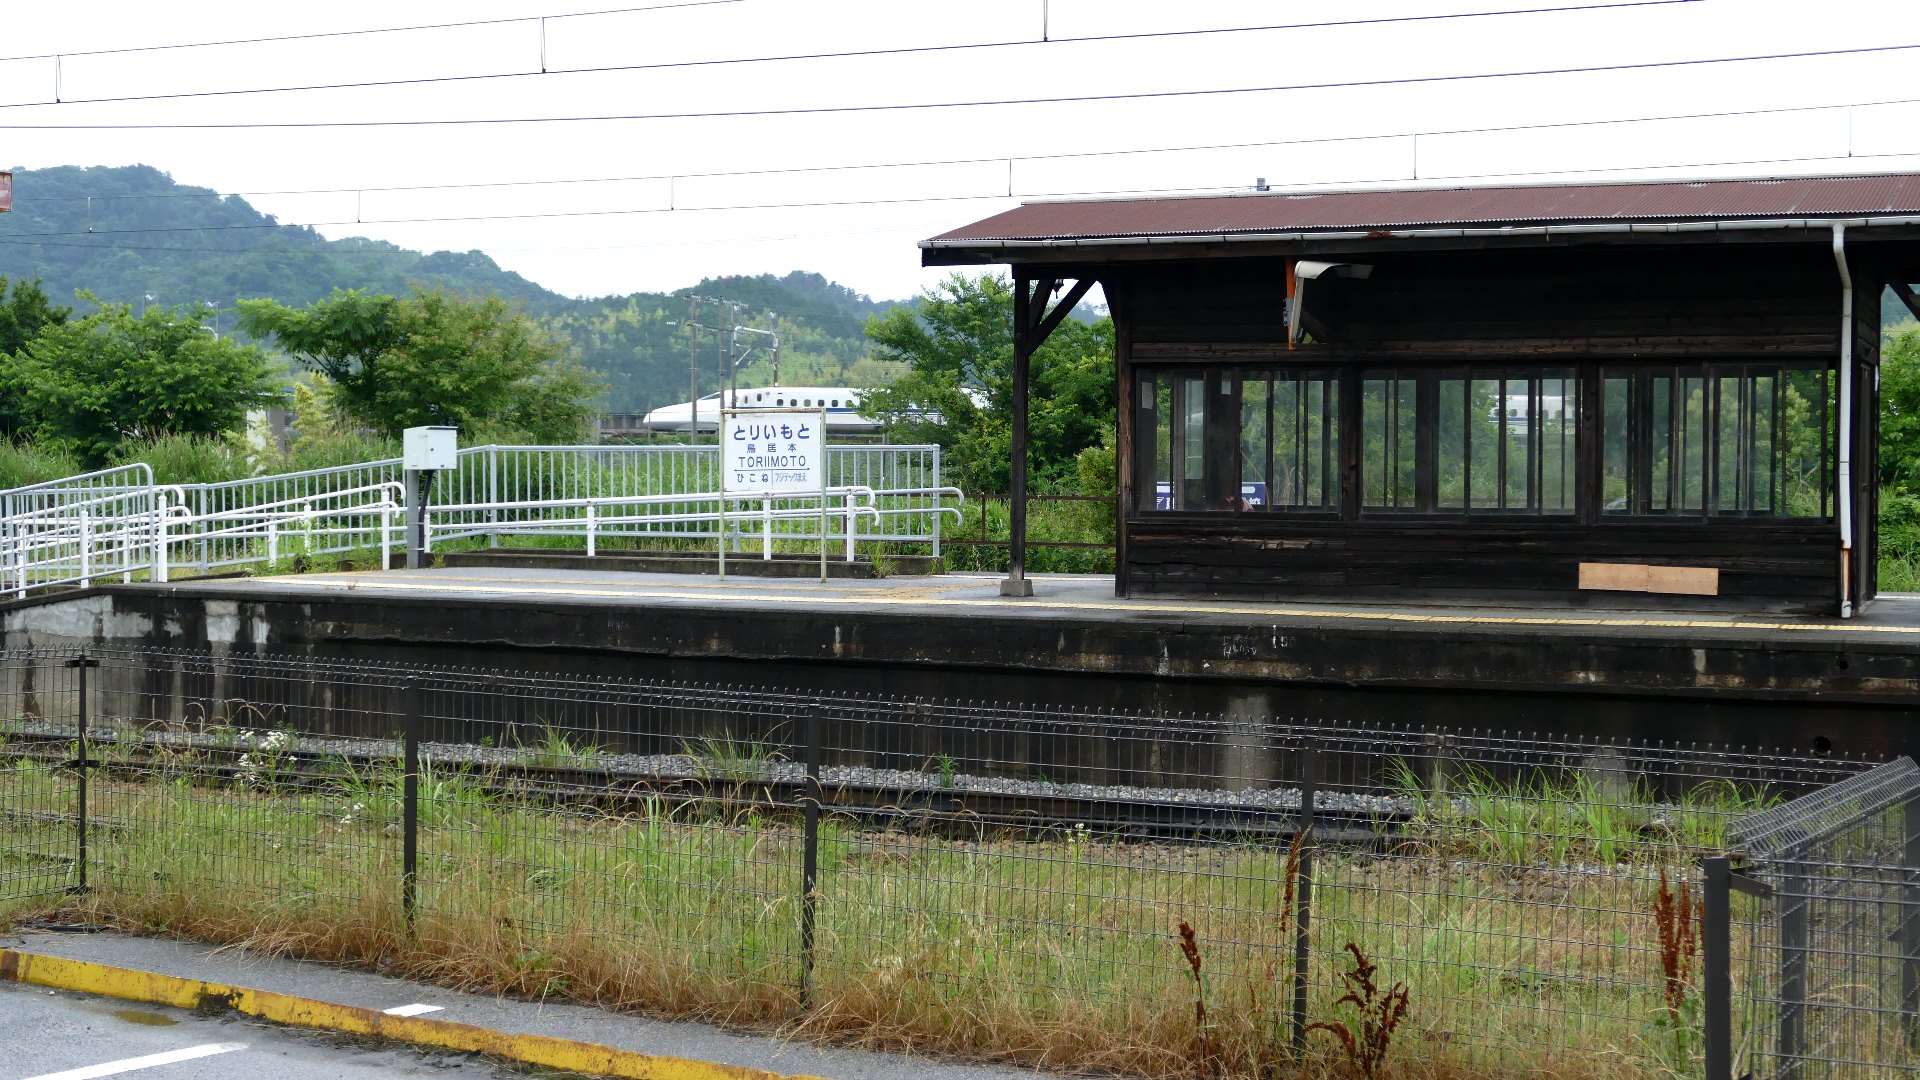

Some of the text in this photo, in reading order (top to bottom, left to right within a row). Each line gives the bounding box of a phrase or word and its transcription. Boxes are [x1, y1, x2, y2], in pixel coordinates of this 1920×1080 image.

[734, 424, 810, 440] とりいもと
[747, 443, 797, 453] 鳥居本
[739, 456, 806, 467] TORIIMOTO
[737, 473, 768, 482] ひこね
